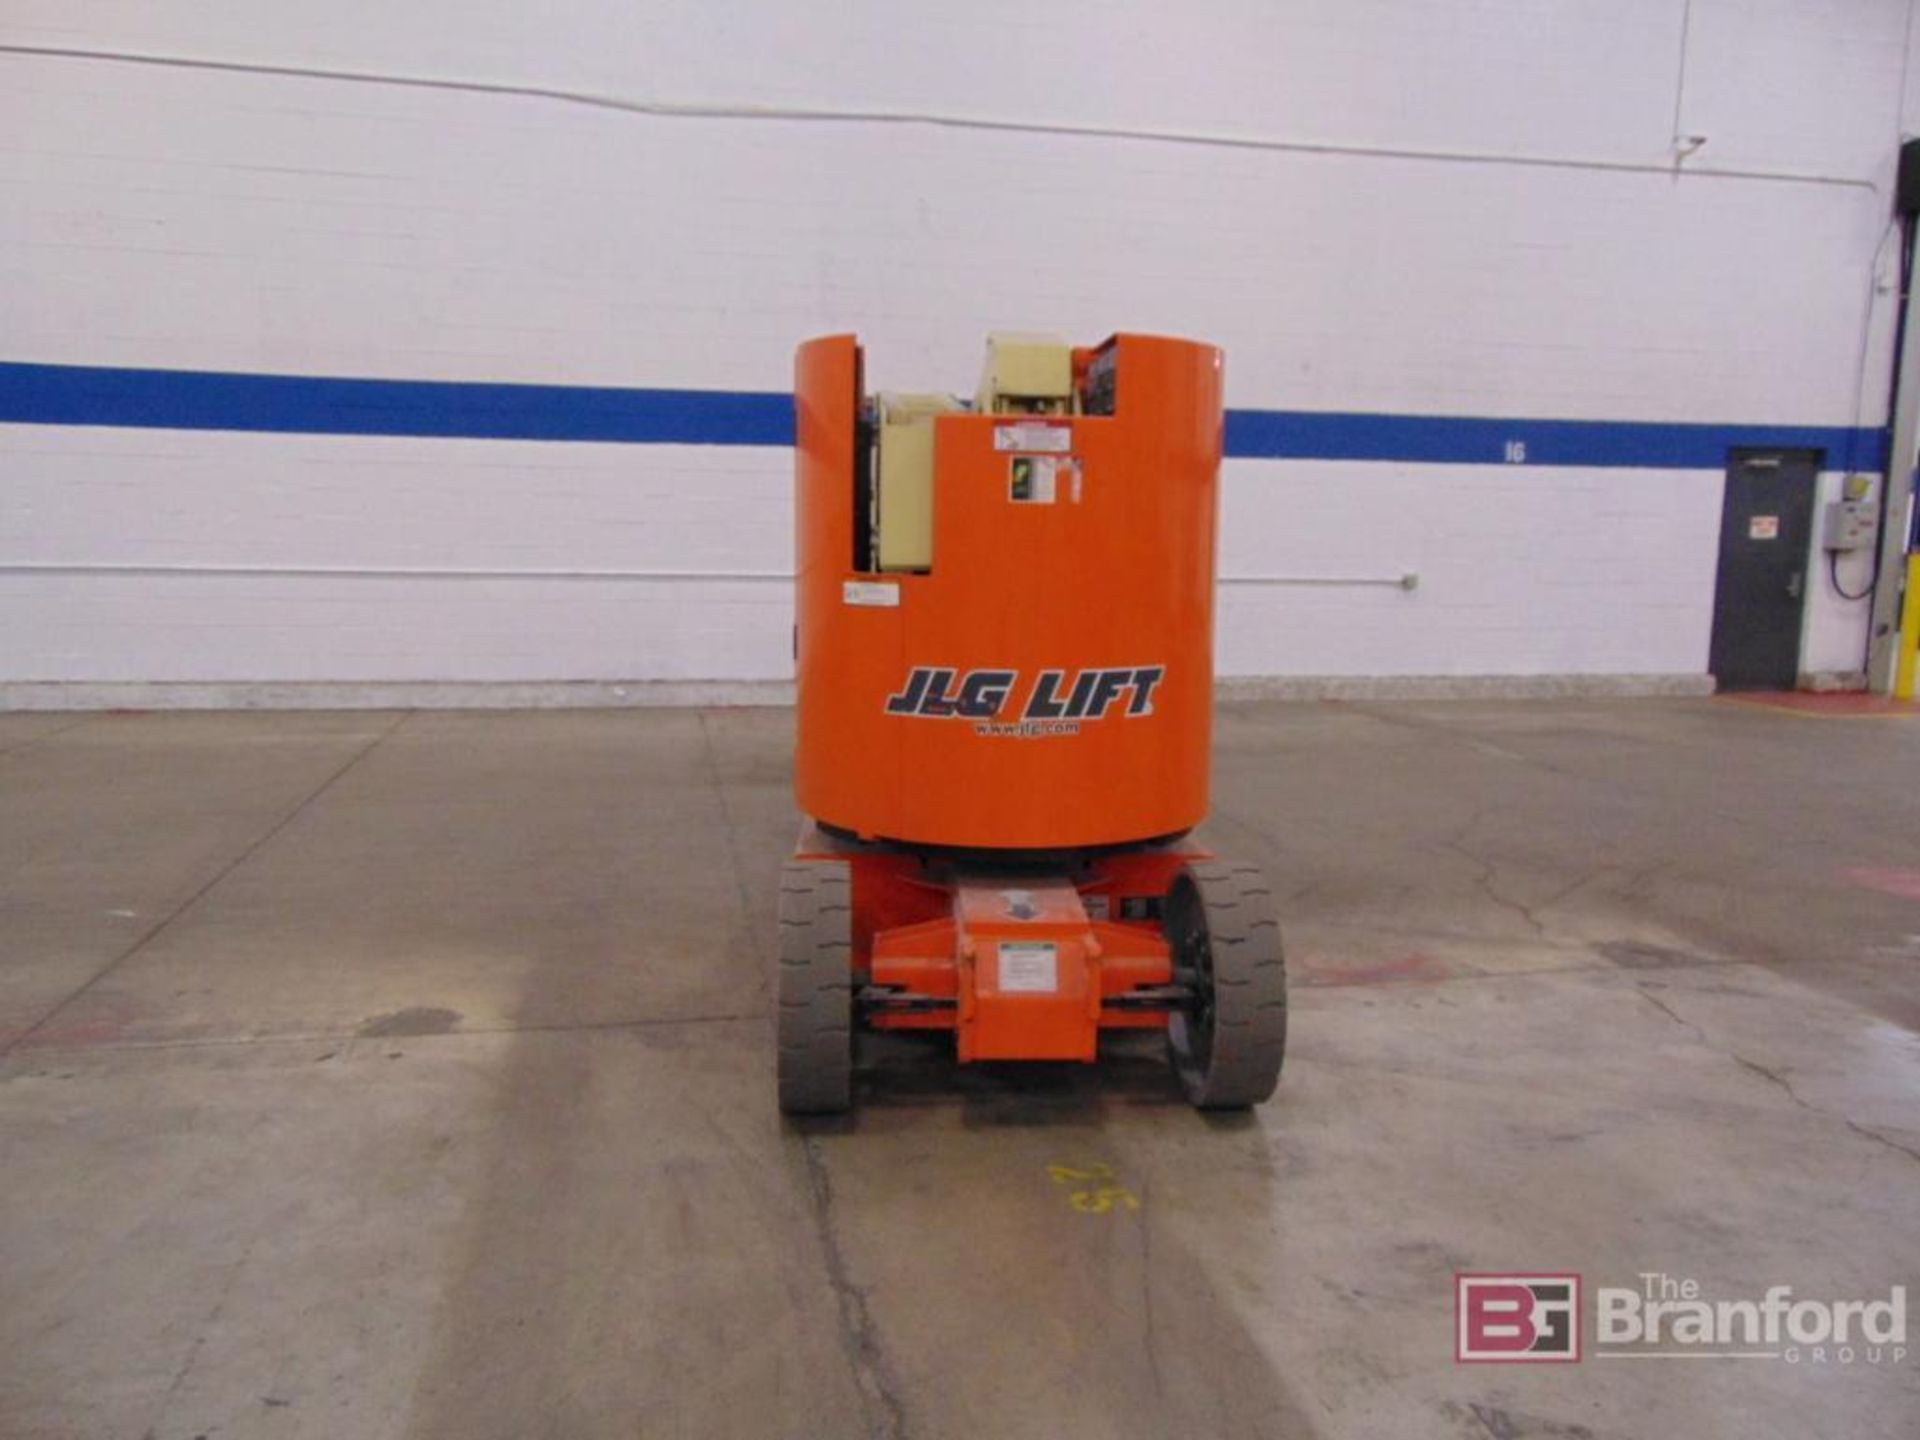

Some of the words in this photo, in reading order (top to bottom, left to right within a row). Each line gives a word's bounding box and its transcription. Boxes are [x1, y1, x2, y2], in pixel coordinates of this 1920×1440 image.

[1505, 440, 1525, 463] 16
[884, 666, 1018, 720] JLG
[1021, 665, 1165, 720] LIFT
[975, 721, 1081, 738] www.jlg.com
